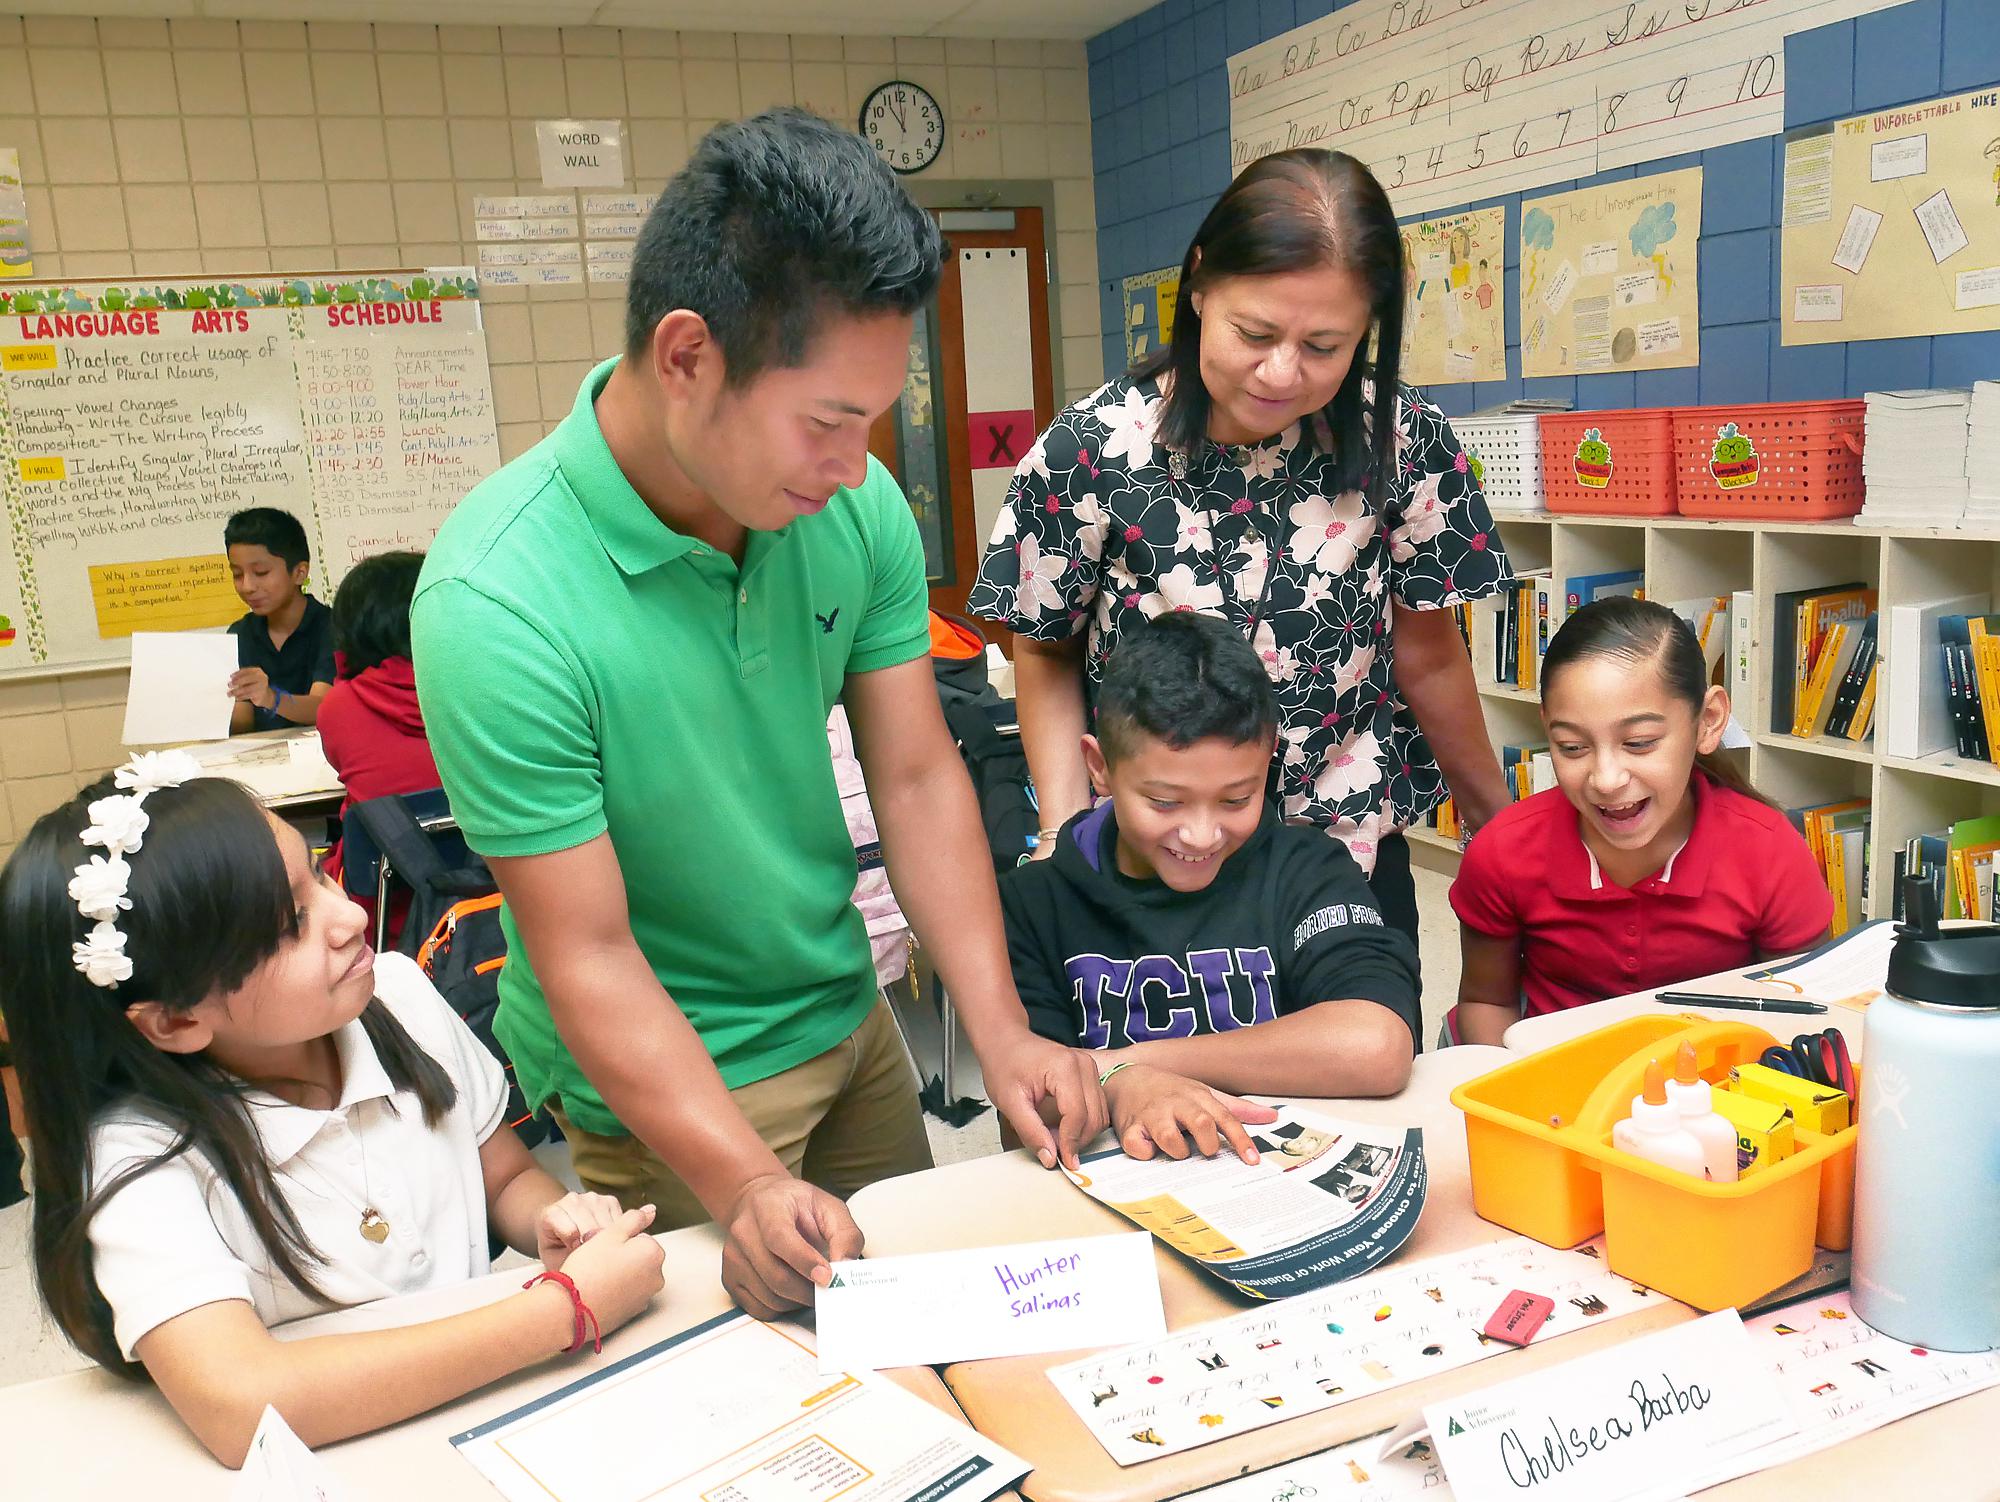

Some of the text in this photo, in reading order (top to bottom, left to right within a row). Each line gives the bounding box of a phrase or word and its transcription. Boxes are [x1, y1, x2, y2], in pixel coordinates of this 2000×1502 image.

[883, 94, 892, 106] 11
[895, 91, 906, 103] 12
[873, 106, 885, 118] 10
[921, 106, 929, 118] 2
[1842, 120, 1867, 136] THE
[1971, 93, 1997, 109] HIKE
[869, 122, 878, 134] 9
[926, 121, 935, 133] 3
[1392, 55, 1775, 189] 3 4 5 6 7 8 9 10
[558, 133, 600, 146] WORD
[875, 139, 884, 150] 8
[924, 138, 932, 149] 4
[563, 155, 600, 168] WALL
[888, 150, 895, 161] 7
[902, 153, 910, 164] 6
[916, 149, 924, 160] 5
[1550, 202, 1586, 228] The
[327, 300, 443, 328] SCHEDULE
[20, 310, 249, 340] LANGUAGE ARTS
[10, 352, 49, 362] WE WILL
[64, 336, 278, 370] Practice correct usage of
[10, 373, 70, 390] Singular
[79, 370, 107, 384] and
[116, 367, 159, 381] Plural
[76, 402, 114, 415] Vowel
[120, 399, 178, 414] Changes
[89, 415, 133, 429] Write
[139, 413, 192, 425] Cursive
[110, 432, 148, 446] The
[153, 427, 209, 450] Writing
[211, 422, 264, 439] Process
[401, 424, 445, 437] Lunch
[988, 425, 1016, 463] X
[34, 466, 55, 474] WILL
[69, 456, 138, 475] Identify
[24, 482, 53, 495] and
[270, 459, 282, 468] in
[72, 488, 98, 502] and
[100, 487, 124, 500] the
[200, 477, 216, 494] by
[120, 518, 145, 531] and
[130, 570, 140, 578] is
[107, 586, 125, 595] and
[1818, 599, 1867, 629] Health
[1294, 903, 1348, 951] HORNED
[1064, 946, 1278, 1051] TCU
[1371, 1199, 1410, 1240] Choose
[1343, 1240, 1375, 1259] Your
[1307, 1255, 1345, 1274] Work
[993, 1252, 1082, 1296] Hunter
[1293, 1268, 1309, 1279] or
[1500, 1373, 1711, 1488] Chelsea Barba
